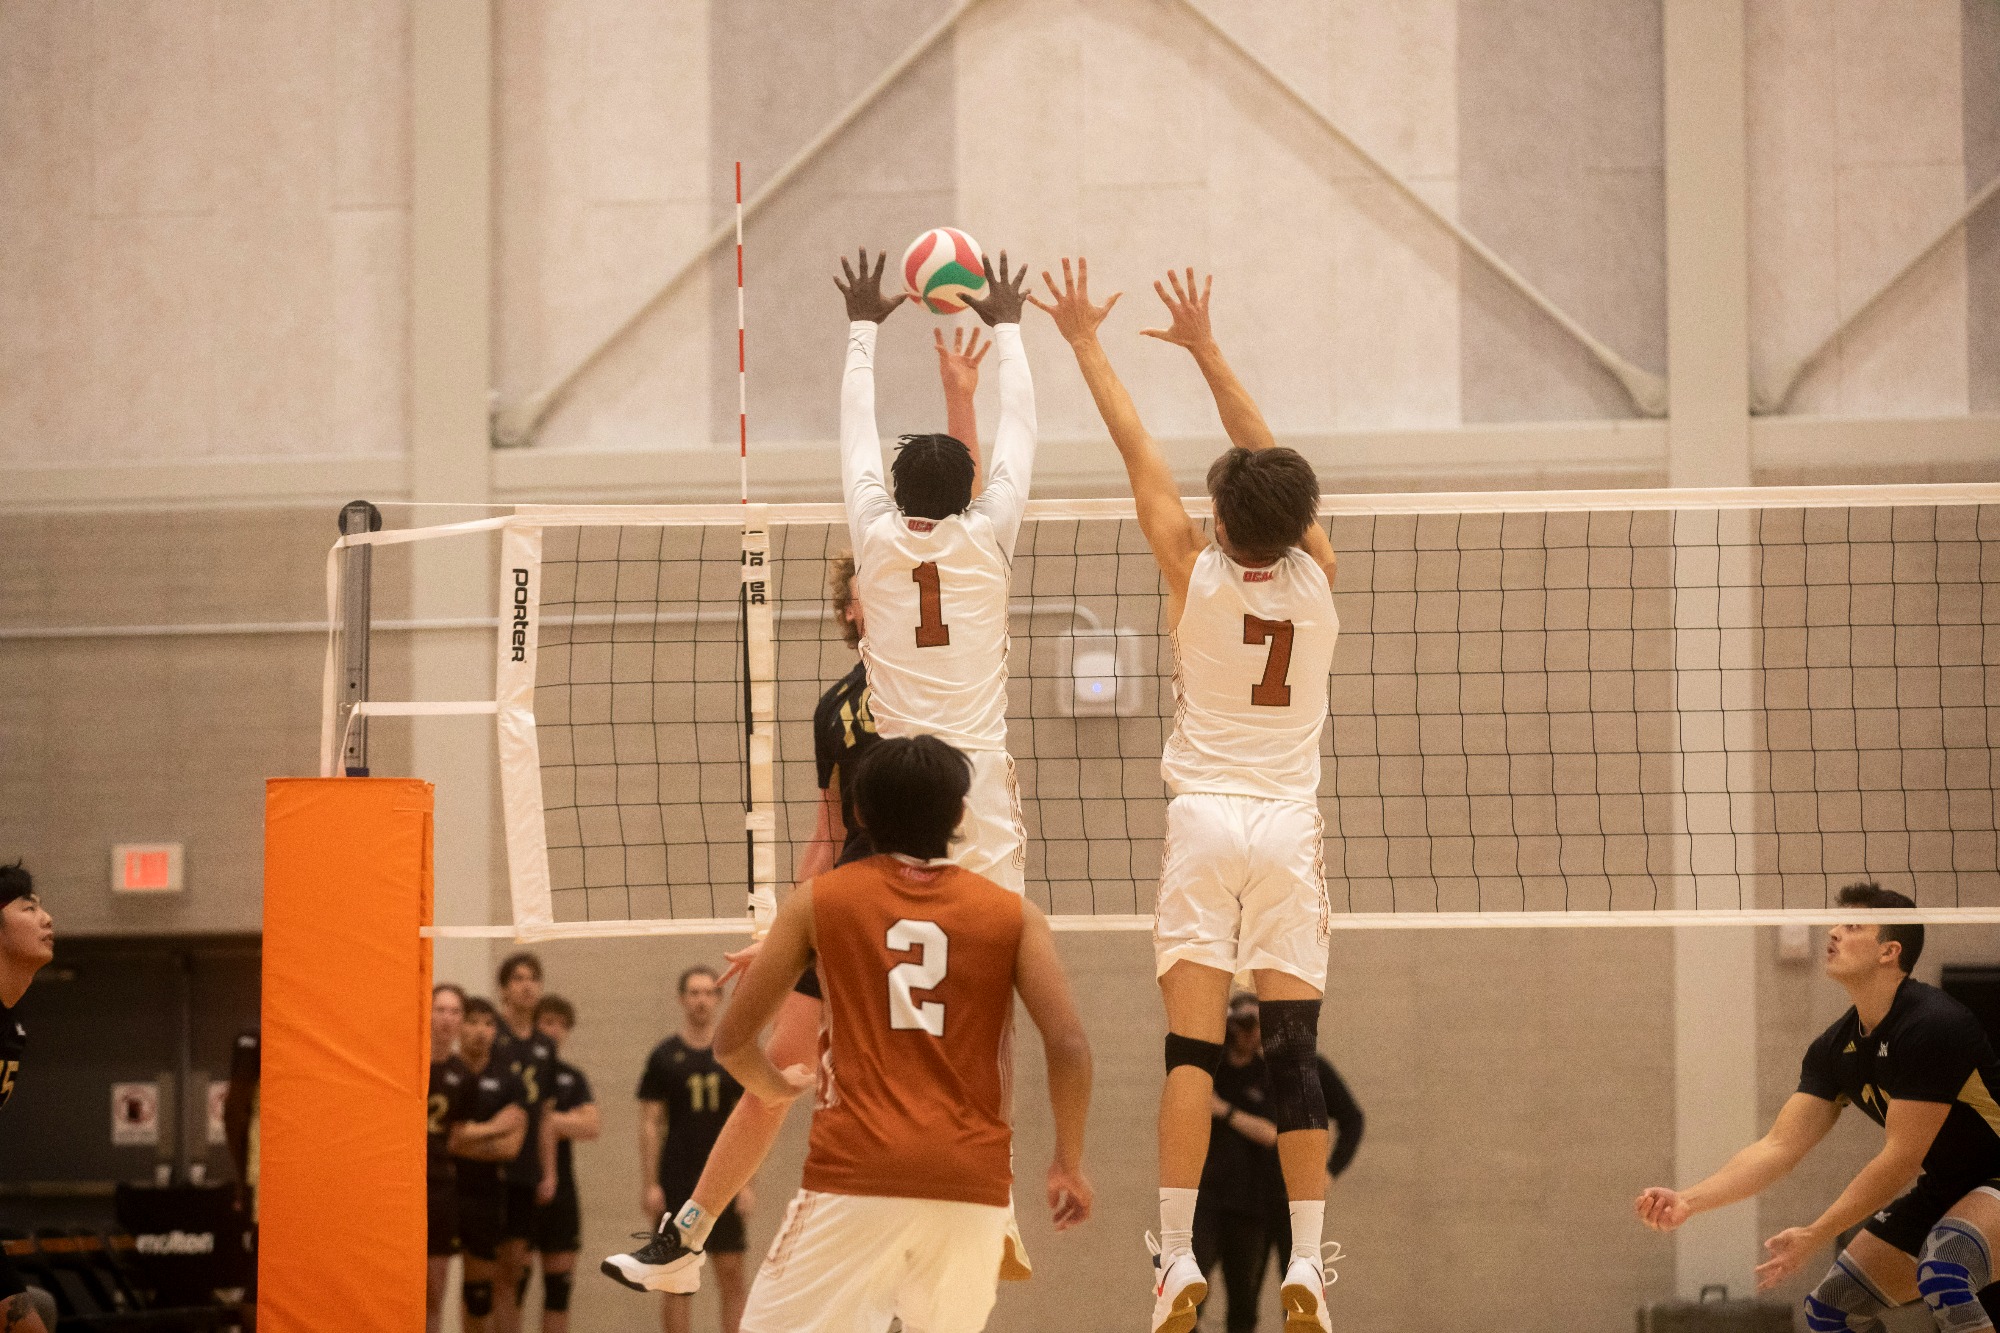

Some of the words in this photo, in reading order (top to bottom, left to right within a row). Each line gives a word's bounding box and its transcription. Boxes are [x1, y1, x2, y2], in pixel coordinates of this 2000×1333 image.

[911, 560, 950, 648] 1
[1242, 613, 1294, 707] 7
[886, 918, 949, 1037] 2
[687, 1072, 721, 1112] 11
